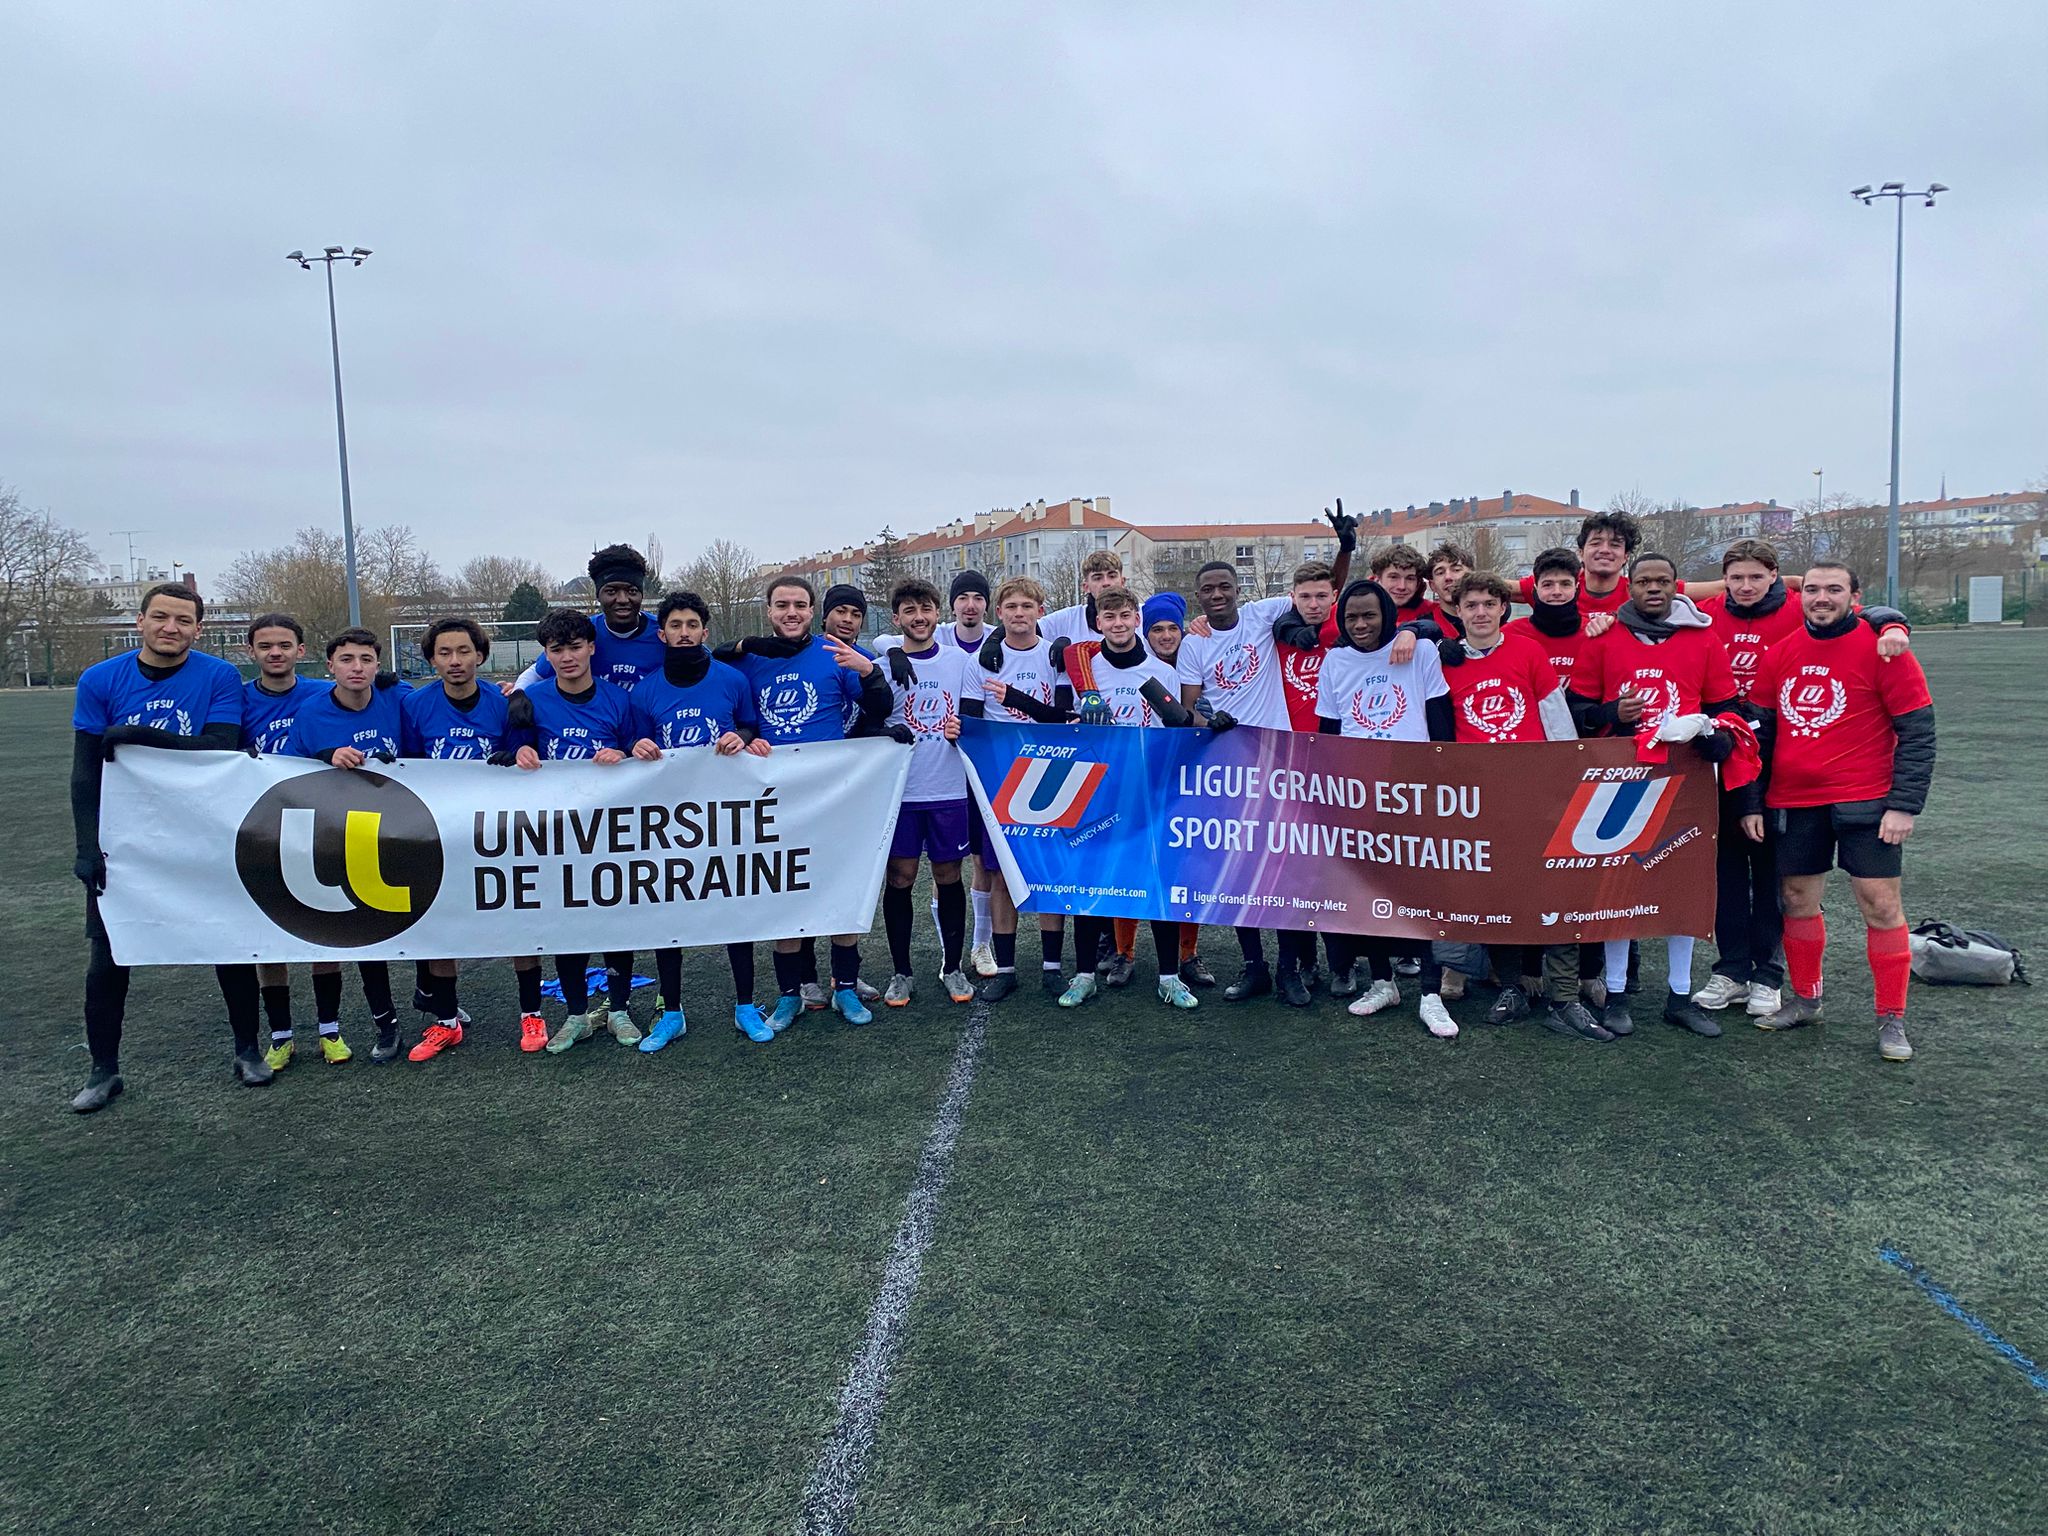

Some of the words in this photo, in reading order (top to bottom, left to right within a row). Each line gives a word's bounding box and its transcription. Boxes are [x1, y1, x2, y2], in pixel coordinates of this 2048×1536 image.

[1734, 633, 1761, 643] FFSU
[1550, 656, 1574, 666] FFSU
[612, 664, 636, 674] FFSU
[1635, 668, 1663, 679] FFSU
[1801, 665, 1830, 676] FFSU
[776, 673, 799, 684] FFSU
[1016, 672, 1037, 681] FFSU
[1366, 675, 1388, 686] FFSU
[919, 681, 939, 690] FFSU
[1115, 687, 1137, 696] FFSU
[1476, 678, 1502, 692] FFSU
[146, 699, 175, 711] FFSU
[676, 708, 701, 720] FFSU
[353, 729, 378, 743] FFSU
[450, 728, 474, 738] FFSU
[563, 728, 588, 738] FFSU
[1018, 743, 1037, 755] FF
[1036, 745, 1078, 759] SPORT
[1582, 767, 1605, 781] FF
[1603, 766, 1654, 781] SPORT
[1179, 765, 1261, 799] LIGUE
[1268, 768, 1367, 810] GRAND
[1375, 781, 1428, 815] EST
[1436, 784, 1481, 819] DU
[473, 787, 780, 858] UNIVERSITÉ
[1001, 826, 1029, 837] AND
[1032, 827, 1059, 838] EST
[1069, 813, 1122, 849] NANCY-METZ
[1168, 816, 1260, 852] SPORT
[1267, 821, 1492, 872] UNIVERSITAIRE
[1642, 826, 1702, 872] NANCY-METZ
[1545, 857, 1597, 869] GRAND
[1601, 854, 1631, 867] EST
[474, 865, 541, 911] DE
[562, 847, 811, 909] LORRAINE
[1028, 883, 1147, 898] www.sport-u-grandest.com
[1193, 891, 1217, 905] Ligue
[1218, 893, 1246, 905] Grand
[1247, 895, 1261, 906] Est
[1262, 896, 1285, 907] FFSU
[1292, 898, 1348, 912] Nancy-Metz
[1397, 905, 1512, 925] @sport_u_nancy_metz
[1563, 904, 1660, 923] @SportUNancyMetz
